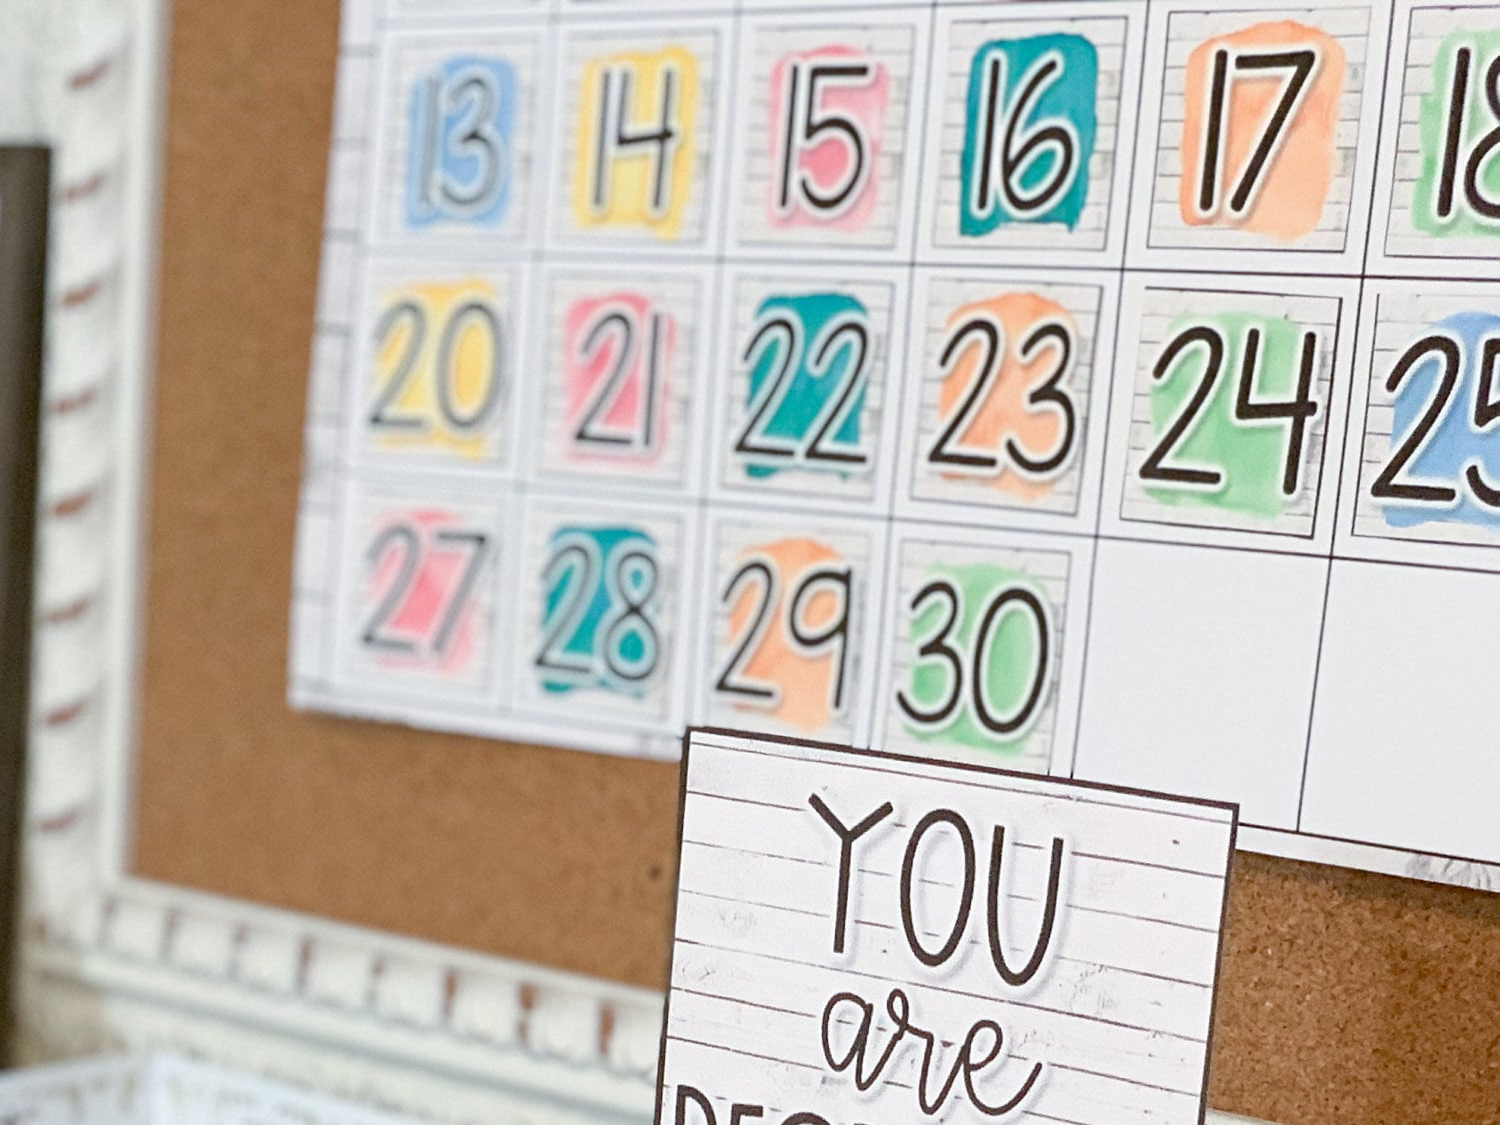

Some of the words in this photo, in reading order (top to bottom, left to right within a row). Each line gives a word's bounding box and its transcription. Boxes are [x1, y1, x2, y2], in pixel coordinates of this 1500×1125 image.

[418, 73, 500, 209] 13
[592, 67, 677, 209] 14
[777, 64, 872, 210] 15
[976, 57, 1073, 211] 16
[1199, 48, 1317, 212] 17
[370, 302, 501, 430] 20
[574, 312, 661, 448] 21
[734, 317, 869, 464] 22
[928, 318, 1076, 473] 23
[1138, 326, 1318, 495] 24
[361, 524, 488, 660] 27
[534, 544, 660, 682] 28
[715, 561, 853, 709] 29
[896, 580, 1049, 735] 30
[807, 792, 1065, 987] YOU
[820, 988, 1043, 1116] are
